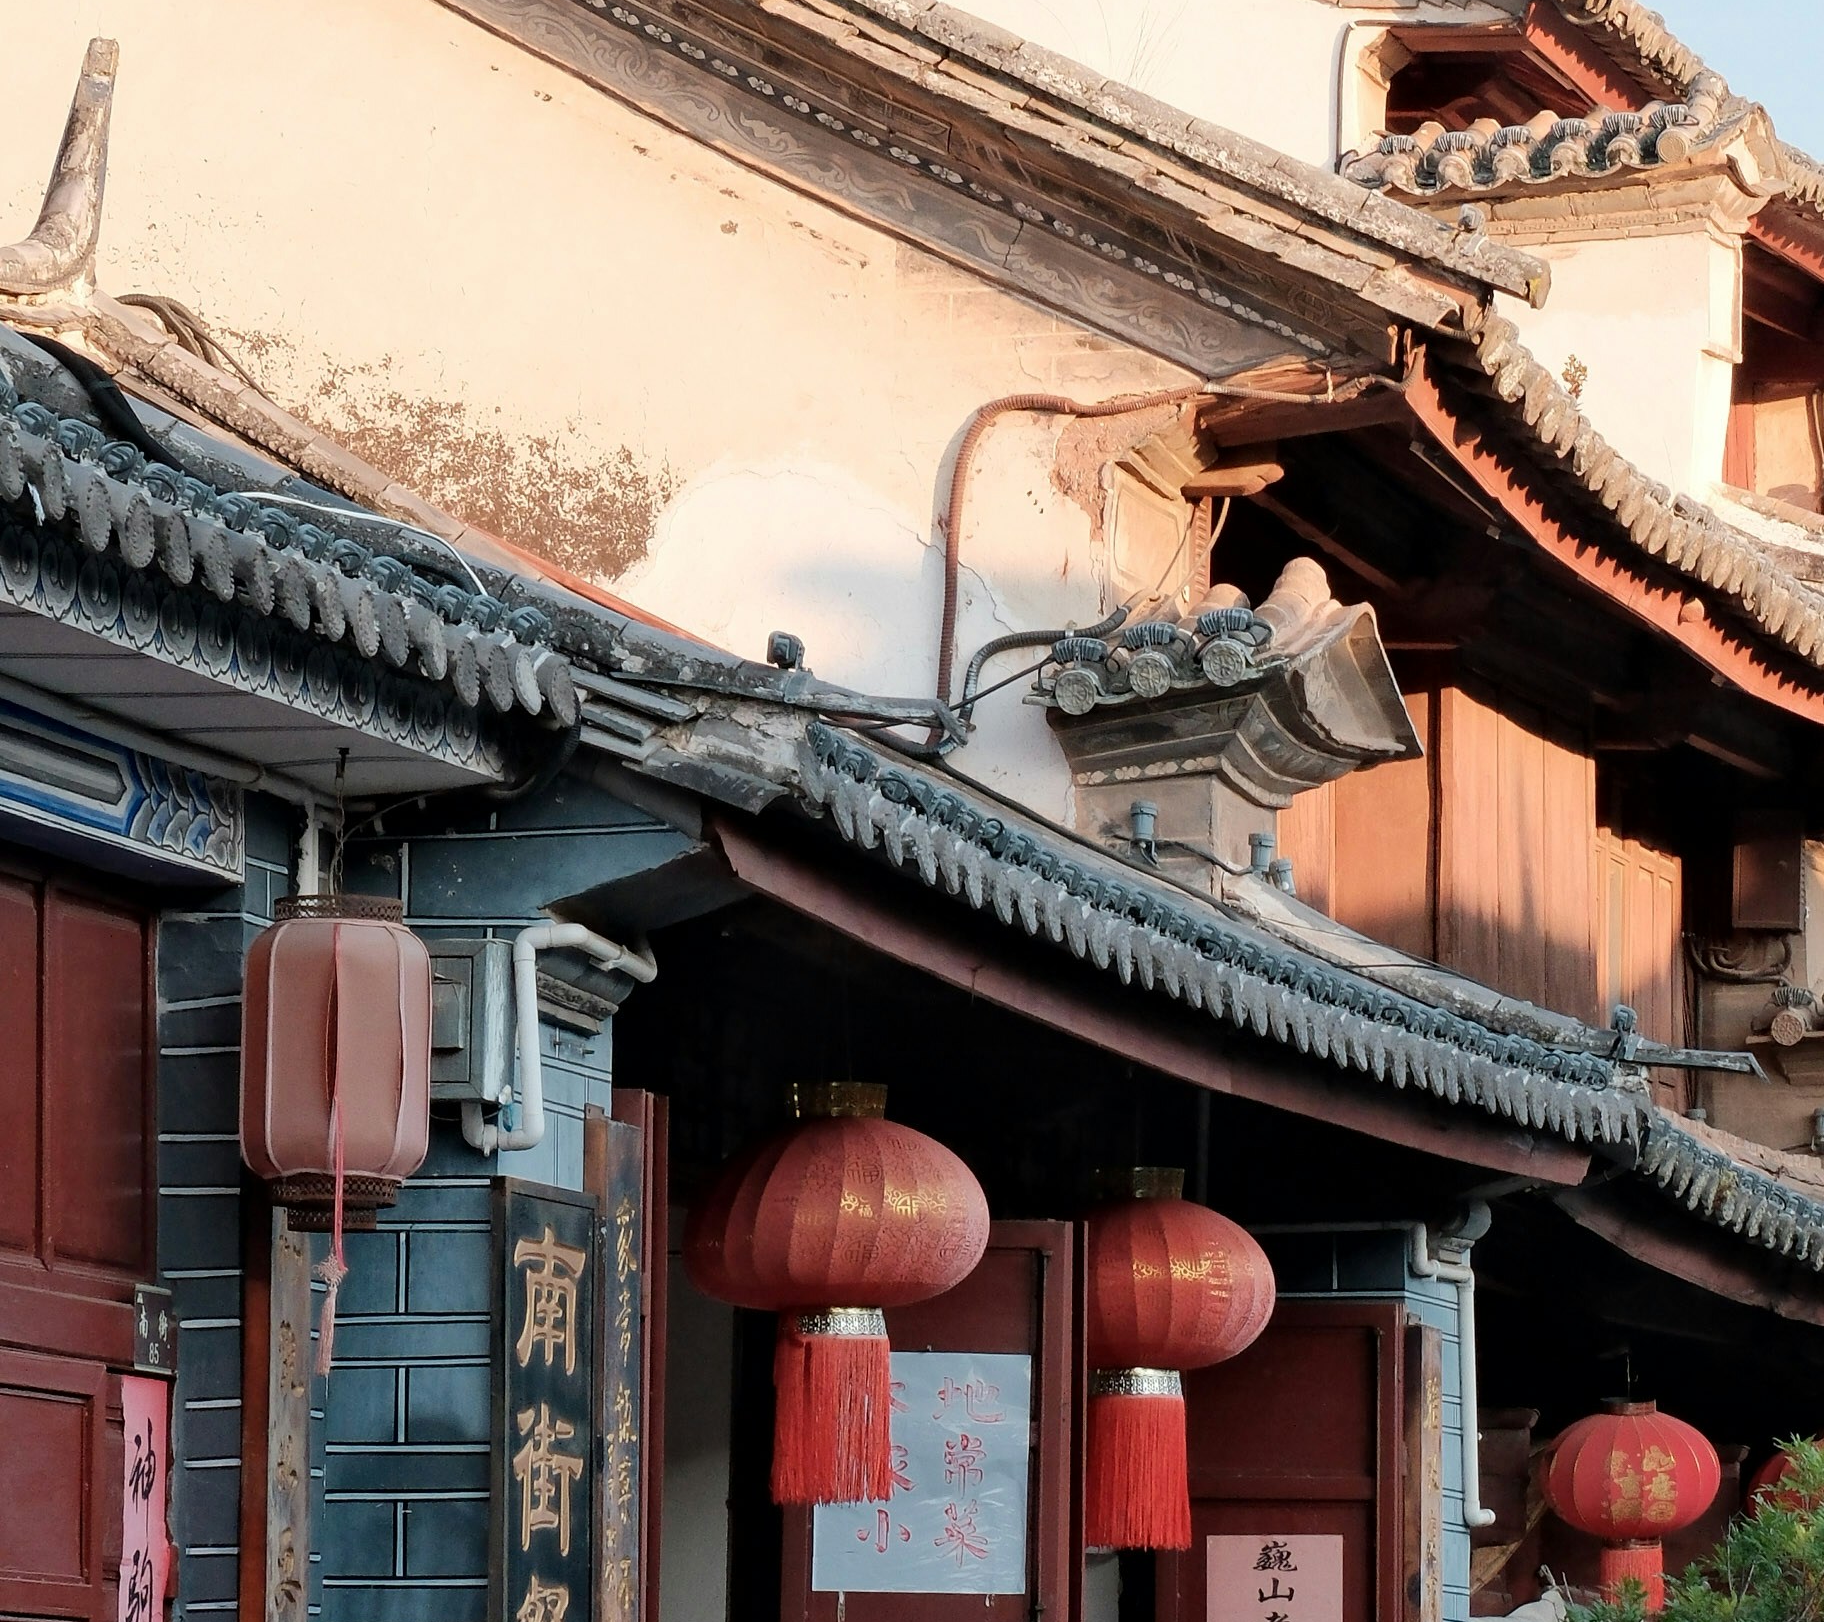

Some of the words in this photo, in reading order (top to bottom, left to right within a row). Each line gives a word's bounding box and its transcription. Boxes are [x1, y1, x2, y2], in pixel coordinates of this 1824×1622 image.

[139, 1305, 168, 1342] 南街
[149, 1342, 160, 1364] 85
[856, 1498, 990, 1569] 小菜
